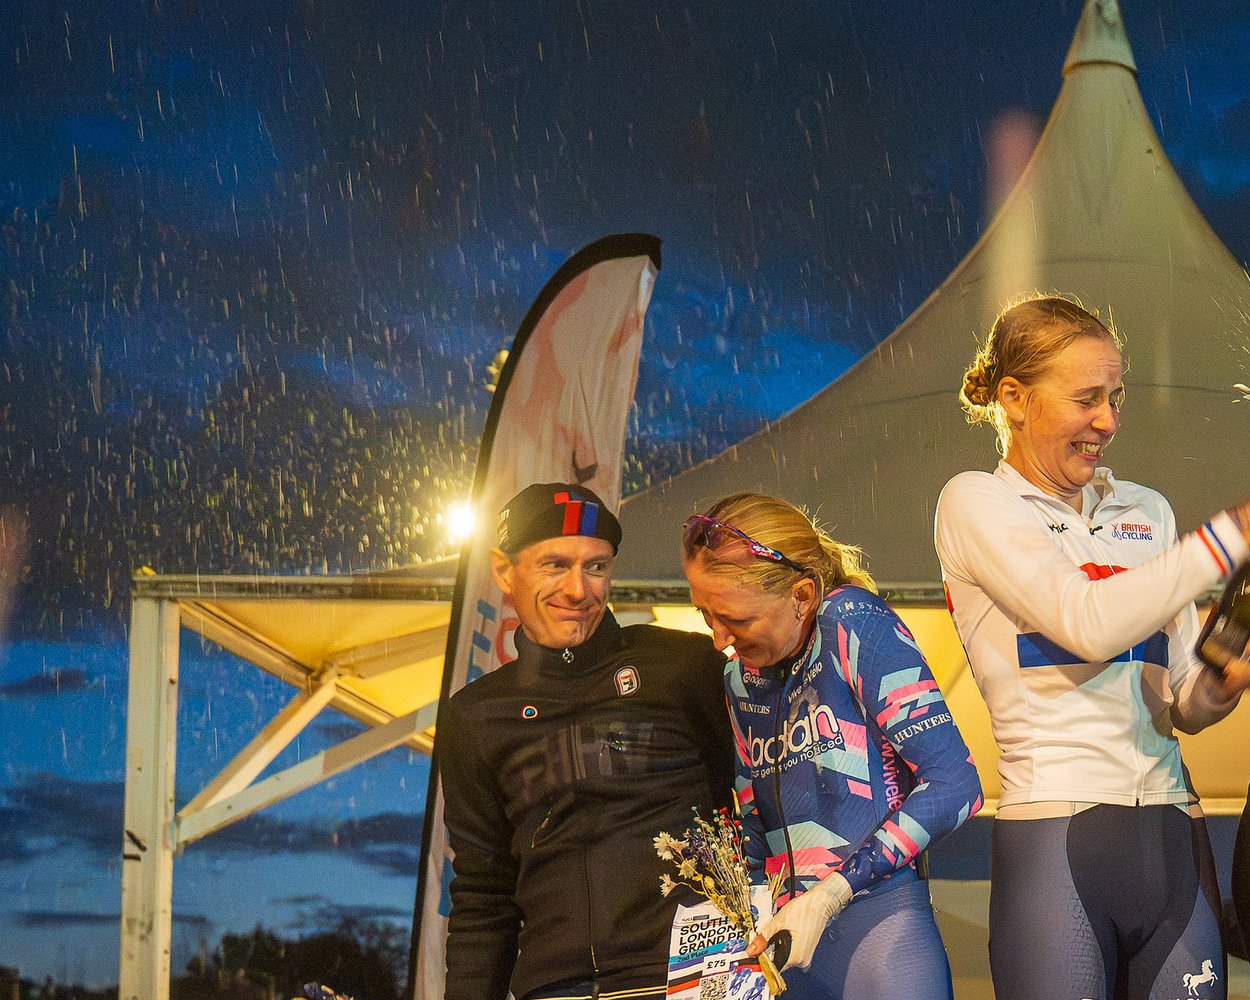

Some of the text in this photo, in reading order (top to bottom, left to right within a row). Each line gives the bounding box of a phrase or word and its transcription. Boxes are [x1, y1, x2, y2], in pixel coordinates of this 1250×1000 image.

[1121, 523, 1152, 532] BRITISH
[1121, 532, 1153, 540] CYCLING
[893, 712, 952, 745] HUNTERS
[800, 732, 844, 763] noticed
[679, 923, 737, 945] LONDON
[680, 916, 729, 935] SOUTH
[679, 935, 725, 955] GRAND
[707, 959, 726, 969] £75
